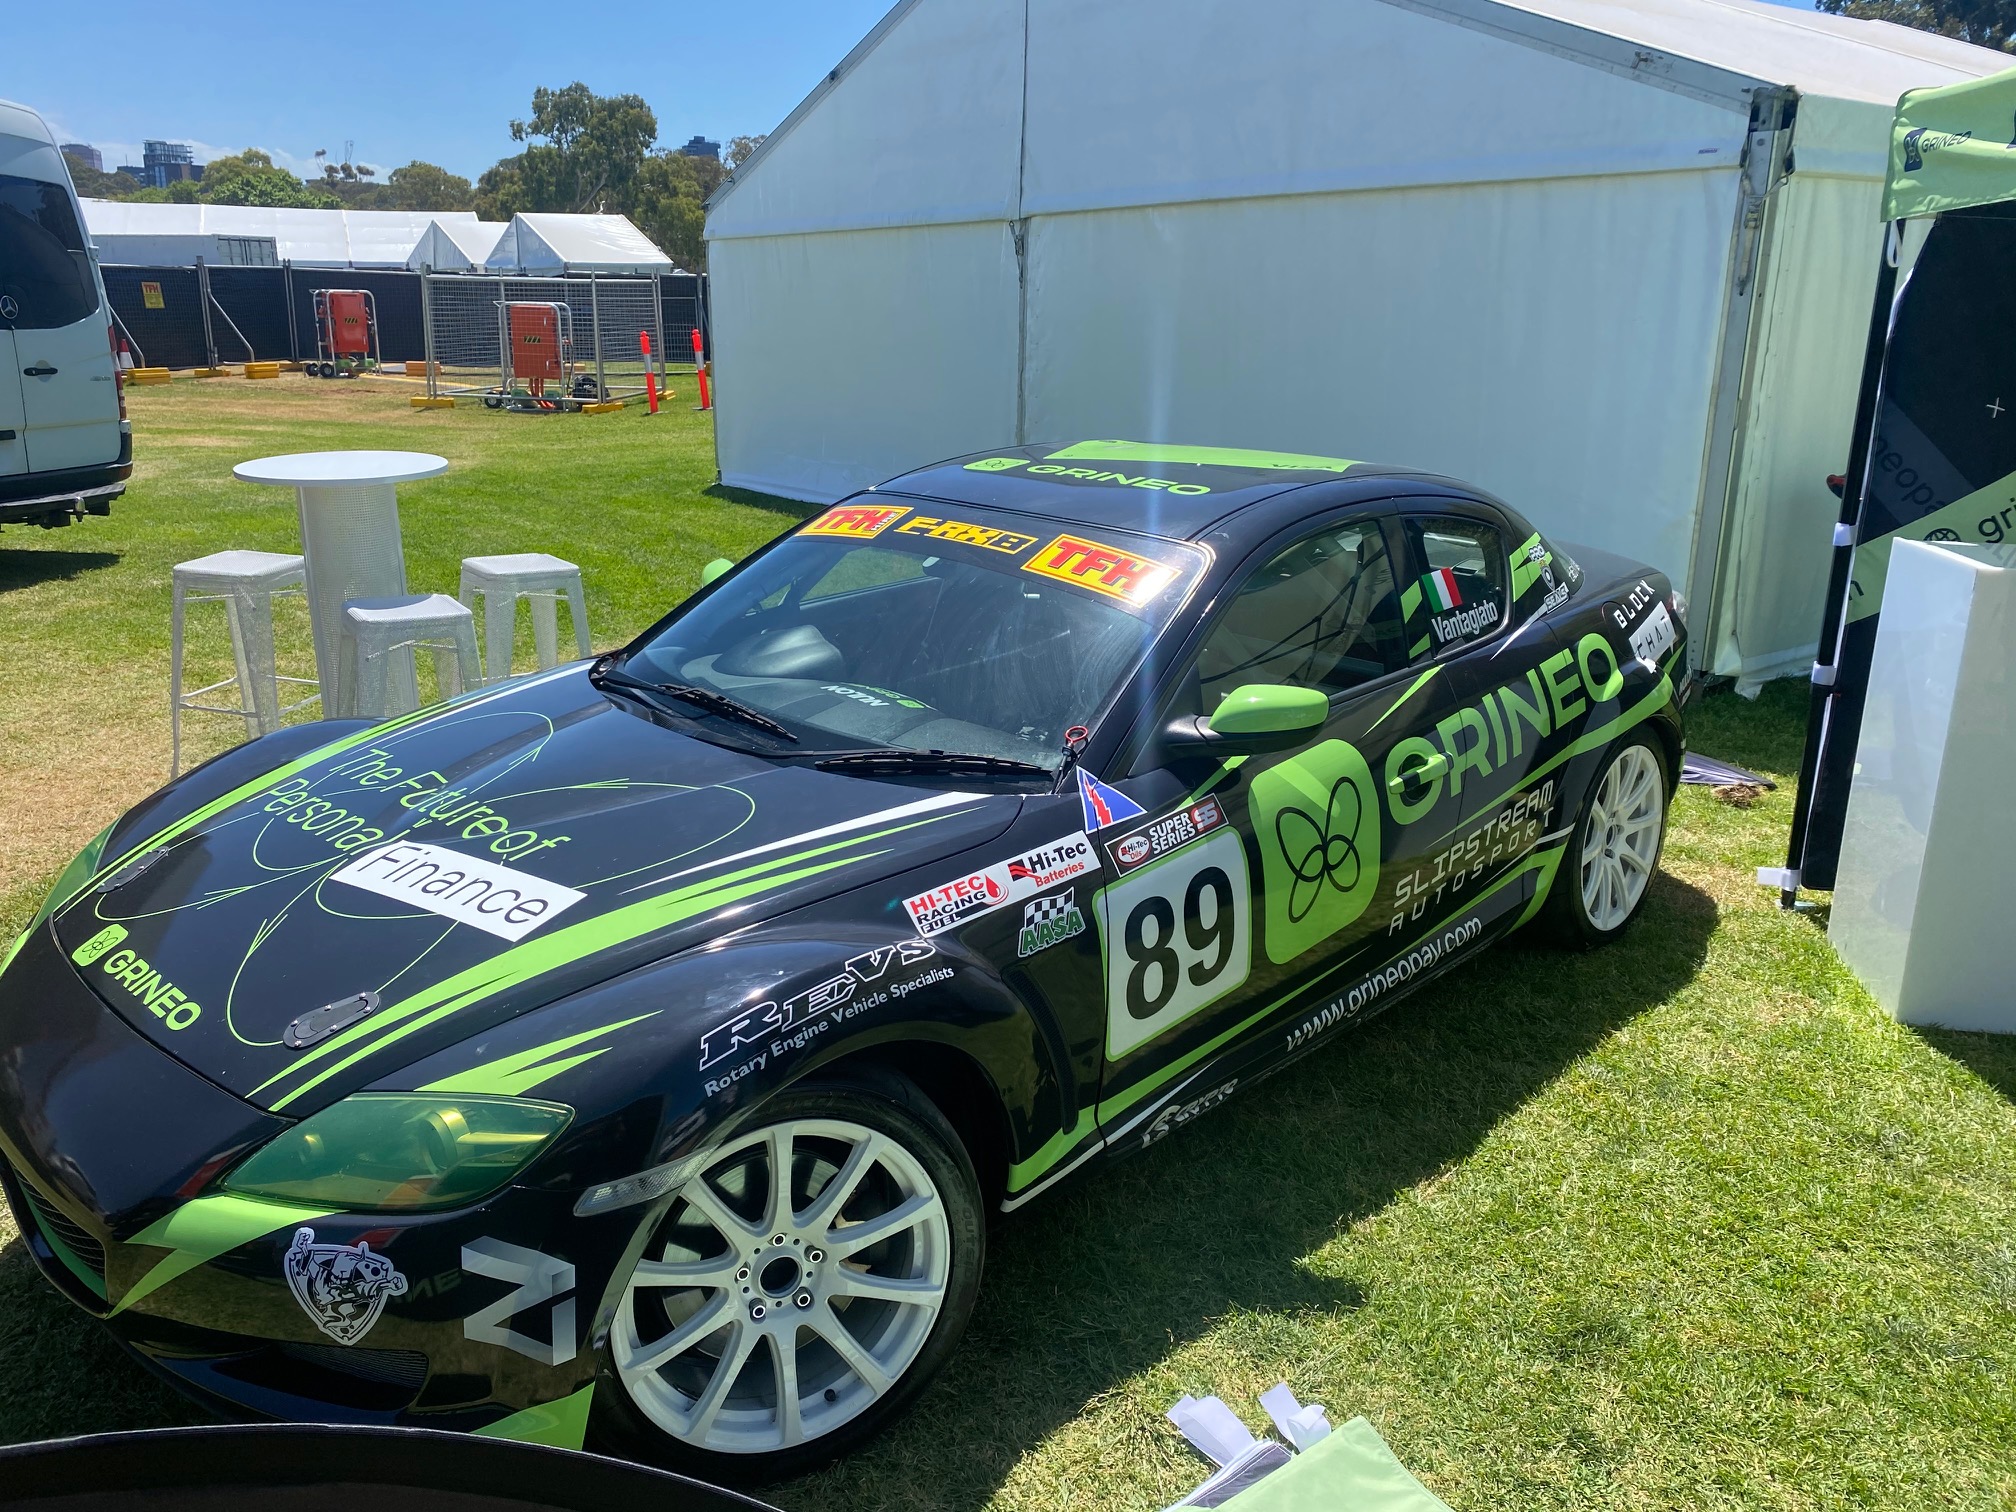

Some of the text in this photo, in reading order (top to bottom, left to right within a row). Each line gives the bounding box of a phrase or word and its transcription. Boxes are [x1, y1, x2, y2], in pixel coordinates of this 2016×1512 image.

[1921, 130, 1972, 154] GRINEO
[1026, 464, 1211, 496] GRINEO
[814, 509, 894, 532] TFH
[1047, 540, 1156, 593] TFH
[1430, 599, 1499, 643] Vantagiato
[1613, 579, 1656, 629] BLOCK
[1386, 632, 1625, 826] GRINEO
[246, 777, 411, 856] Personal
[328, 747, 572, 861] The Future of
[1148, 812, 1191, 841] SUPER
[1027, 841, 1087, 874] Hi-Tec
[1127, 838, 1149, 853] Hi-Tec
[1151, 823, 1196, 855] SERIES
[1393, 778, 1554, 909] SLIPSTREAM
[356, 845, 550, 924] Finance
[909, 875, 985, 916] HI-TEC
[1034, 860, 1085, 888] Batteries
[1387, 805, 1554, 937] AUTOSPORT
[915, 890, 988, 926] RACING
[921, 913, 962, 935] FUEL
[1019, 907, 1086, 957] AASA
[1124, 866, 1235, 1021] 89
[103, 948, 203, 1032] GRINEO
[1285, 915, 1483, 1053] www.grineopay.com
[703, 966, 955, 1098] Rotary Engine Vehicle Specialists
